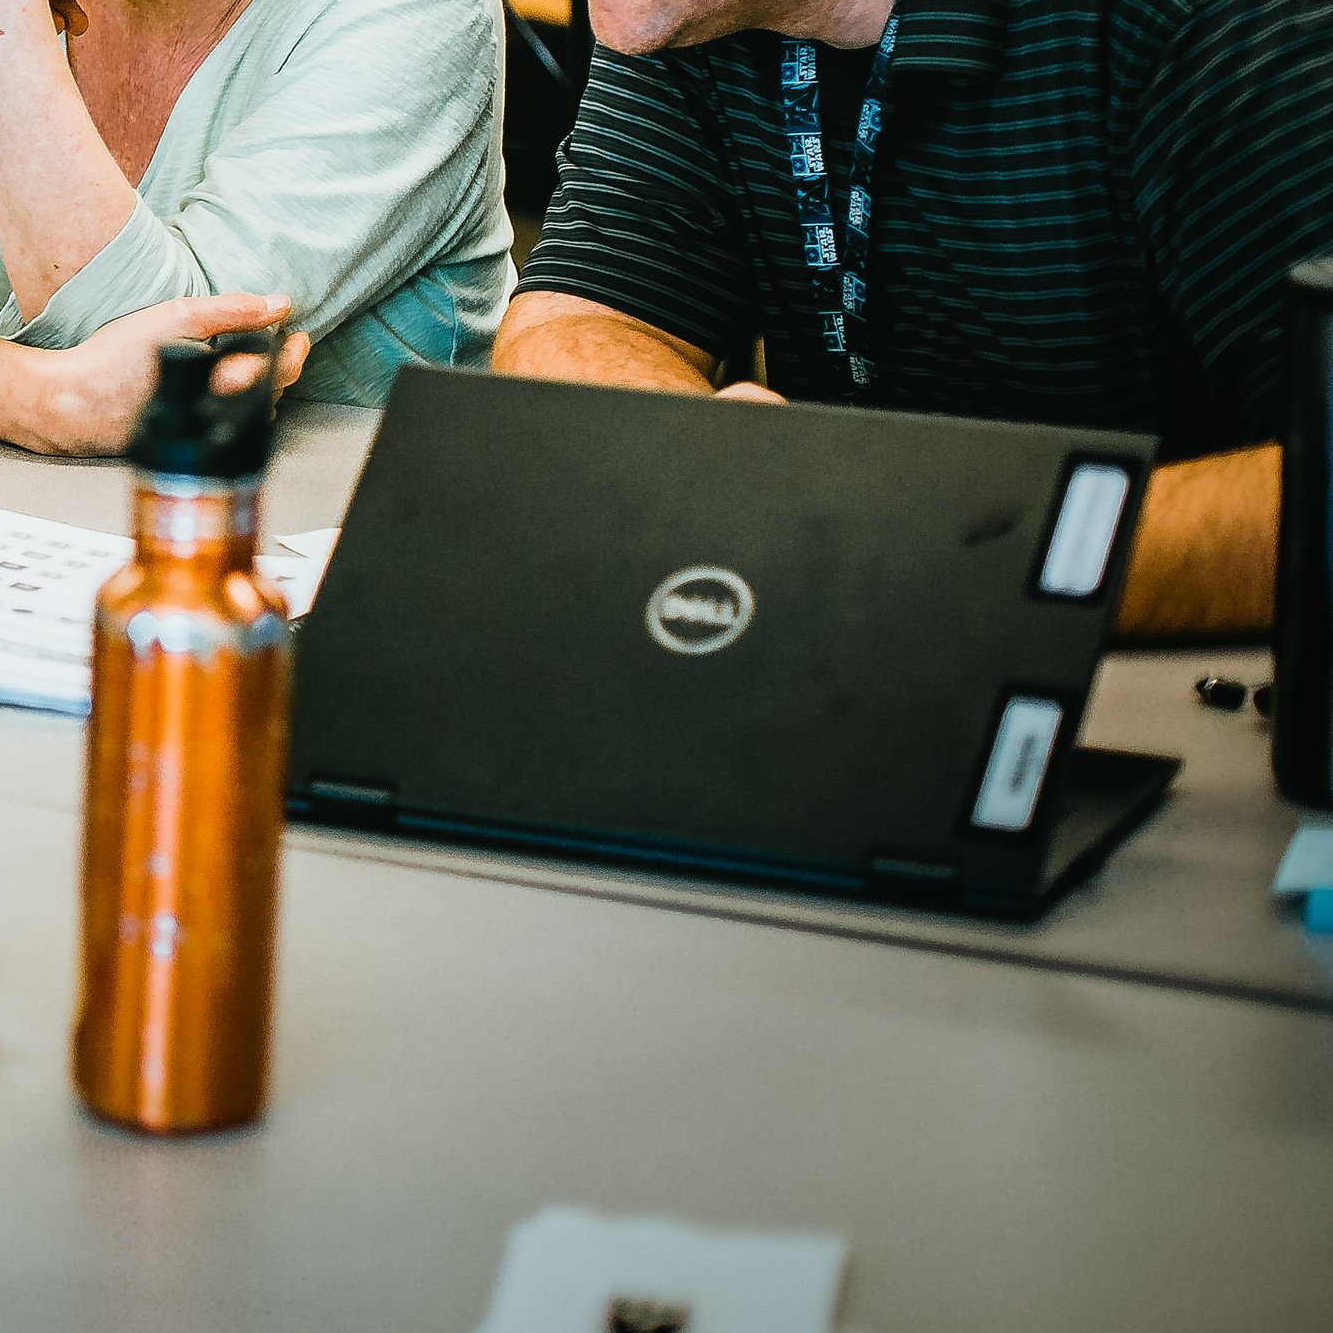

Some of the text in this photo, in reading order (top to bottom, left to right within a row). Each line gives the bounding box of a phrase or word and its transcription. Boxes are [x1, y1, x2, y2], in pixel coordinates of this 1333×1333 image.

[798, 47, 808, 77] STAR
[804, 46, 817, 81] WARS
[805, 136, 816, 168] STAR
[812, 137, 825, 172] WARS
[819, 227, 830, 259] STAR
[825, 227, 838, 262] WARS
